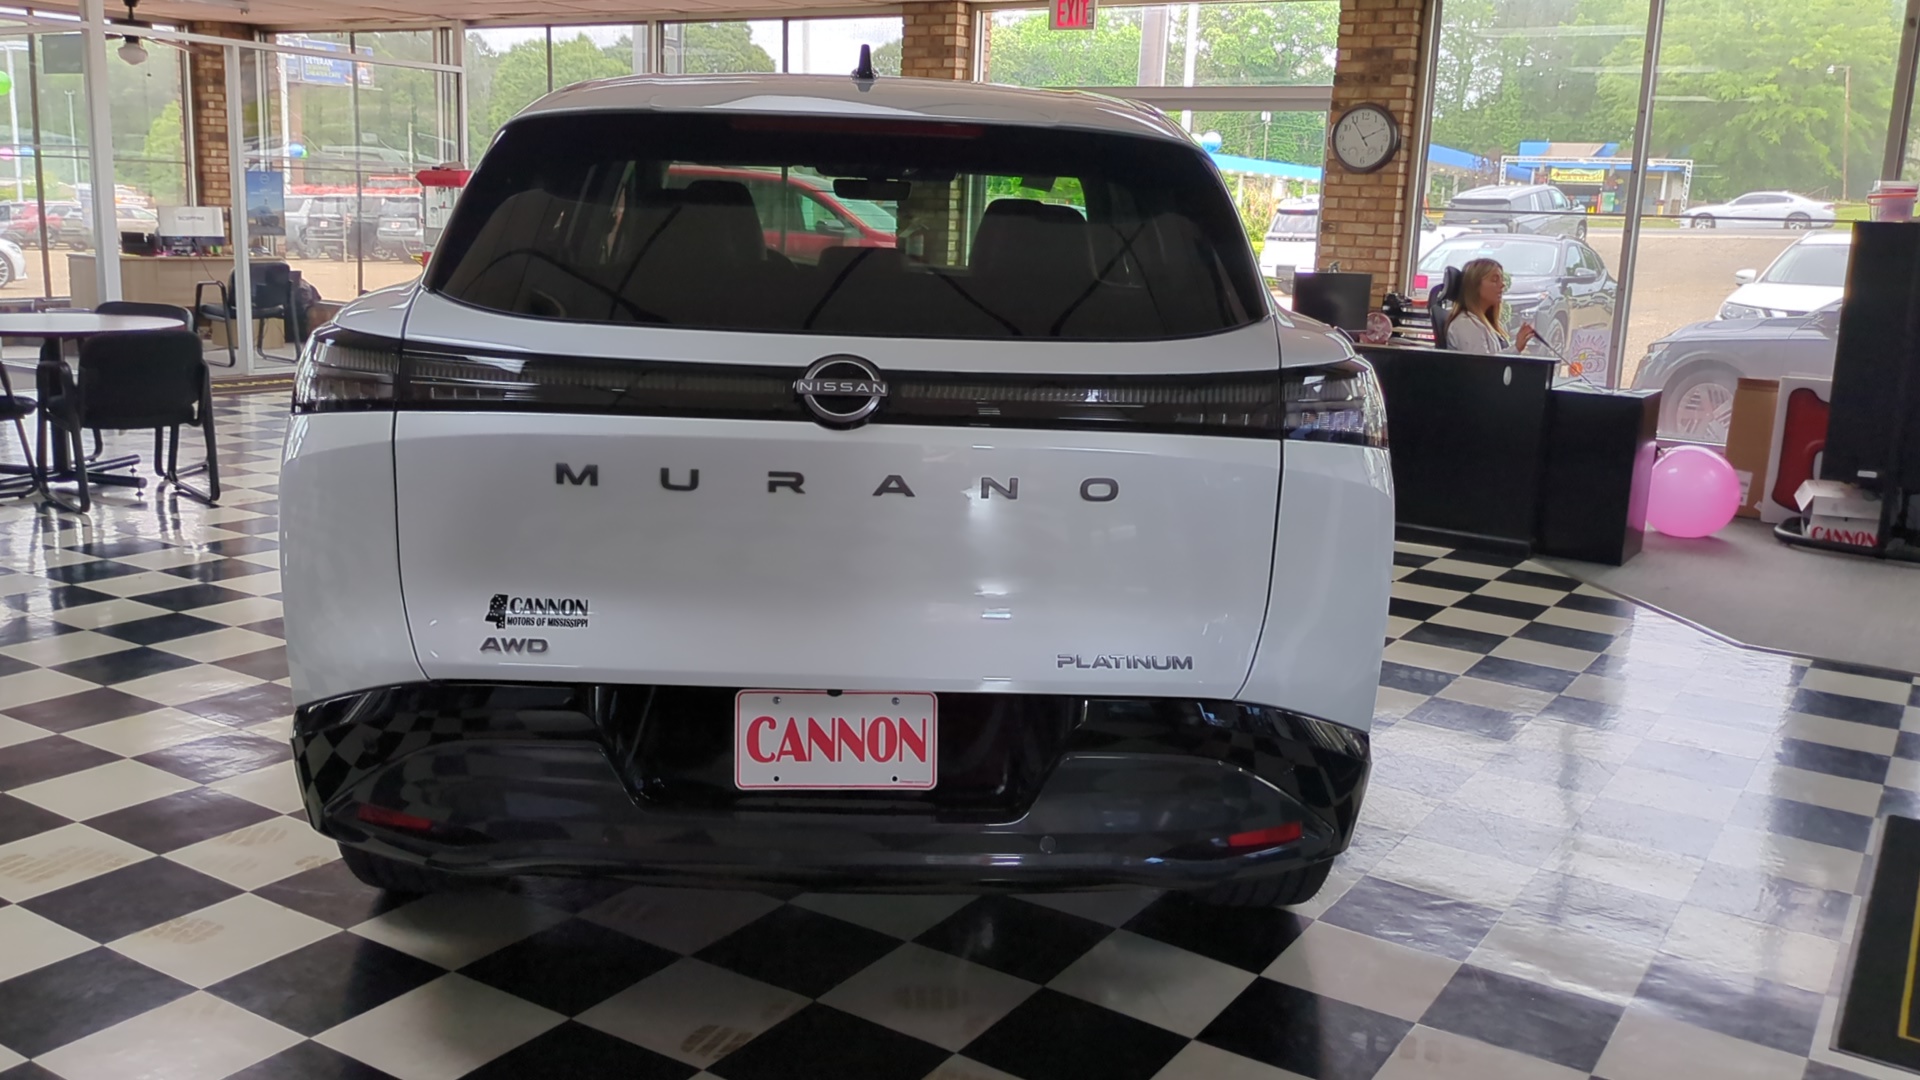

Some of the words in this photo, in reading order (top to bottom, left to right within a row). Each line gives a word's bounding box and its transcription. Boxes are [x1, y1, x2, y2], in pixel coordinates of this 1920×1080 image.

[1057, 0, 1089, 26] EXIT
[1361, 112, 1370, 120] 12
[800, 381, 886, 394] NISSAN
[555, 461, 1120, 502] MURANO
[1811, 526, 1879, 548] CANNON
[509, 597, 588, 616] CANNON
[507, 617, 535, 626] MOTORS
[536, 618, 546, 627] OF
[547, 618, 588, 628] MISSISSIPPI
[480, 637, 548, 653] AWD
[1057, 653, 1193, 670] PLATINUM
[746, 715, 927, 763] CANNON
